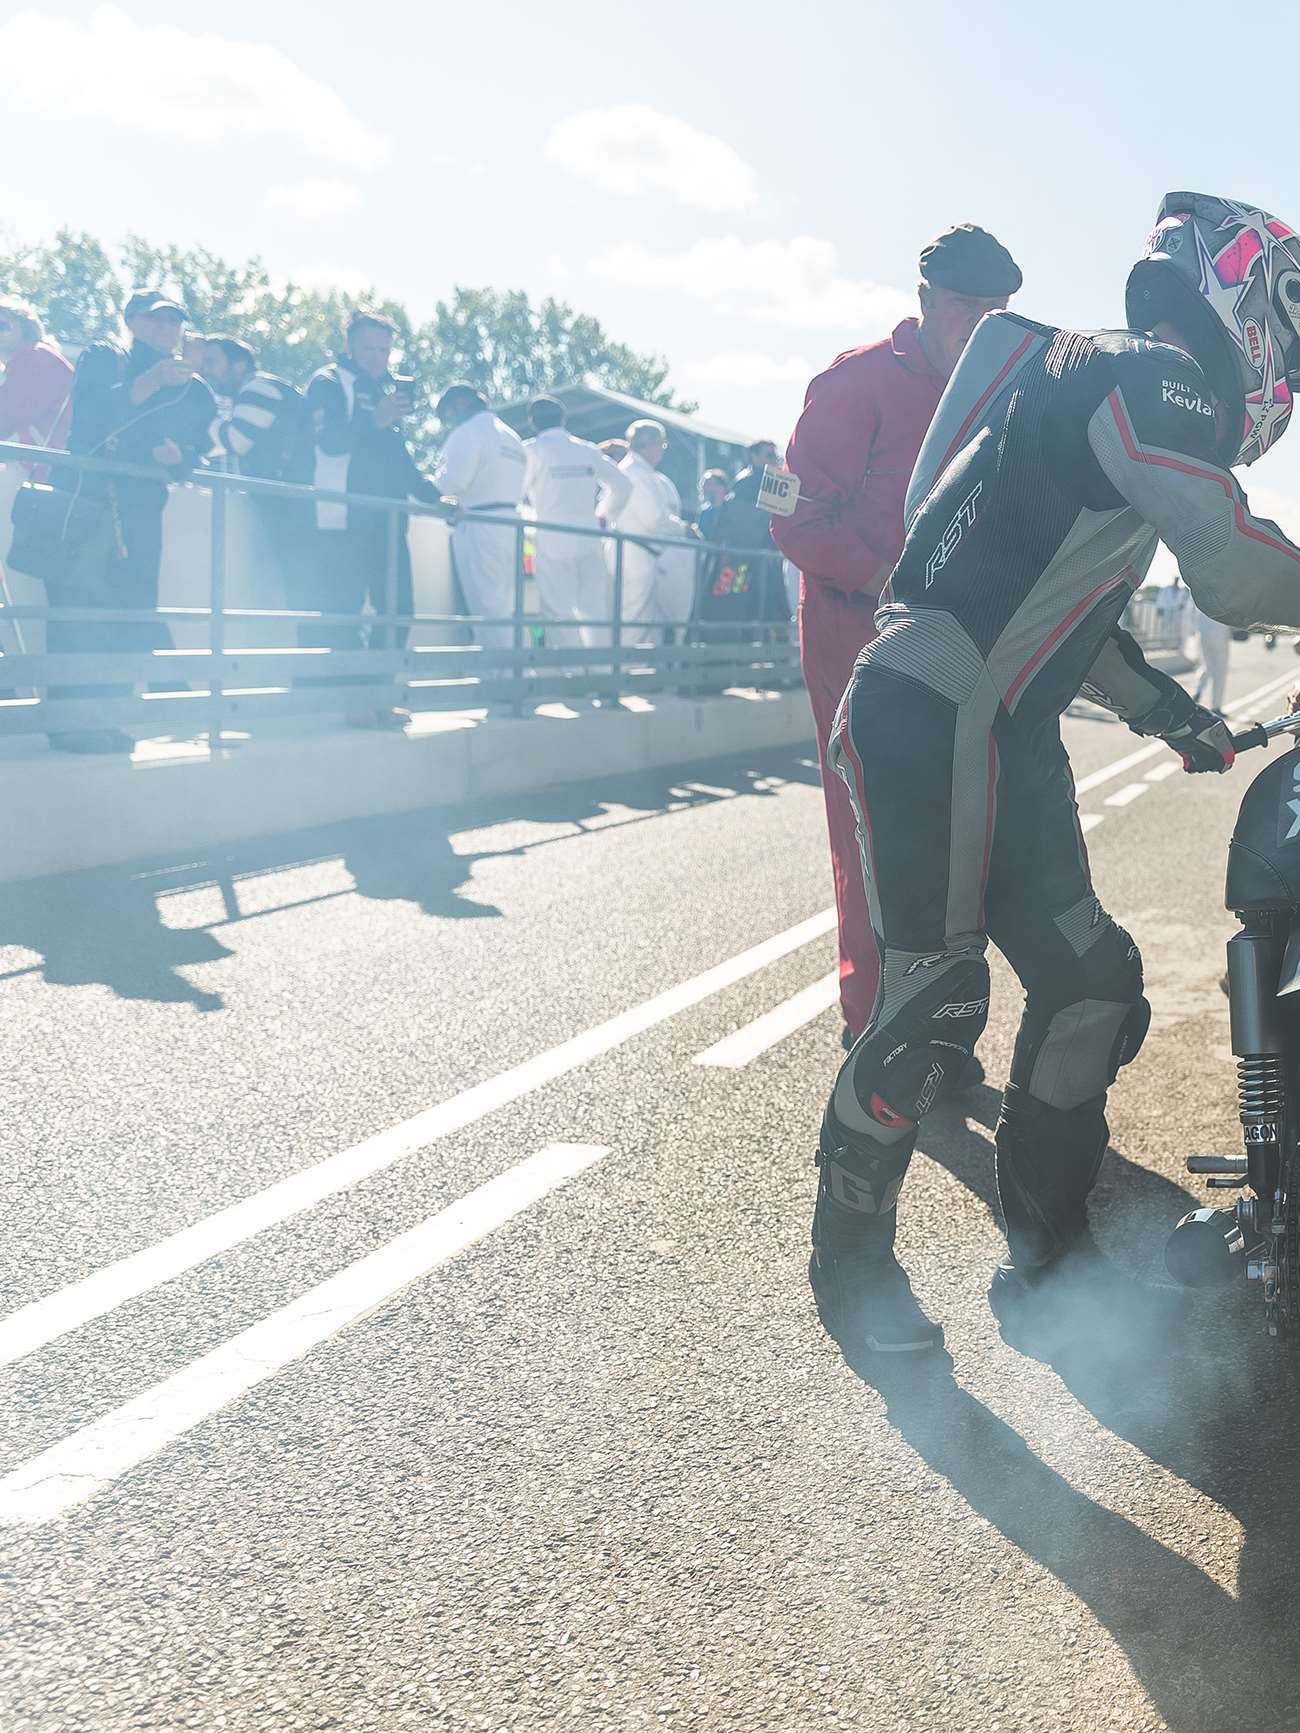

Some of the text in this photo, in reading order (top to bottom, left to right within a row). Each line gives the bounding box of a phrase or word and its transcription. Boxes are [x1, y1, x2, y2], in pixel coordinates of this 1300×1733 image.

[1246, 325, 1263, 364] BELL
[1162, 379, 1191, 392] BUILT
[925, 480, 982, 590] RST
[930, 996, 989, 1019] RST
[914, 1062, 945, 1114] RST
